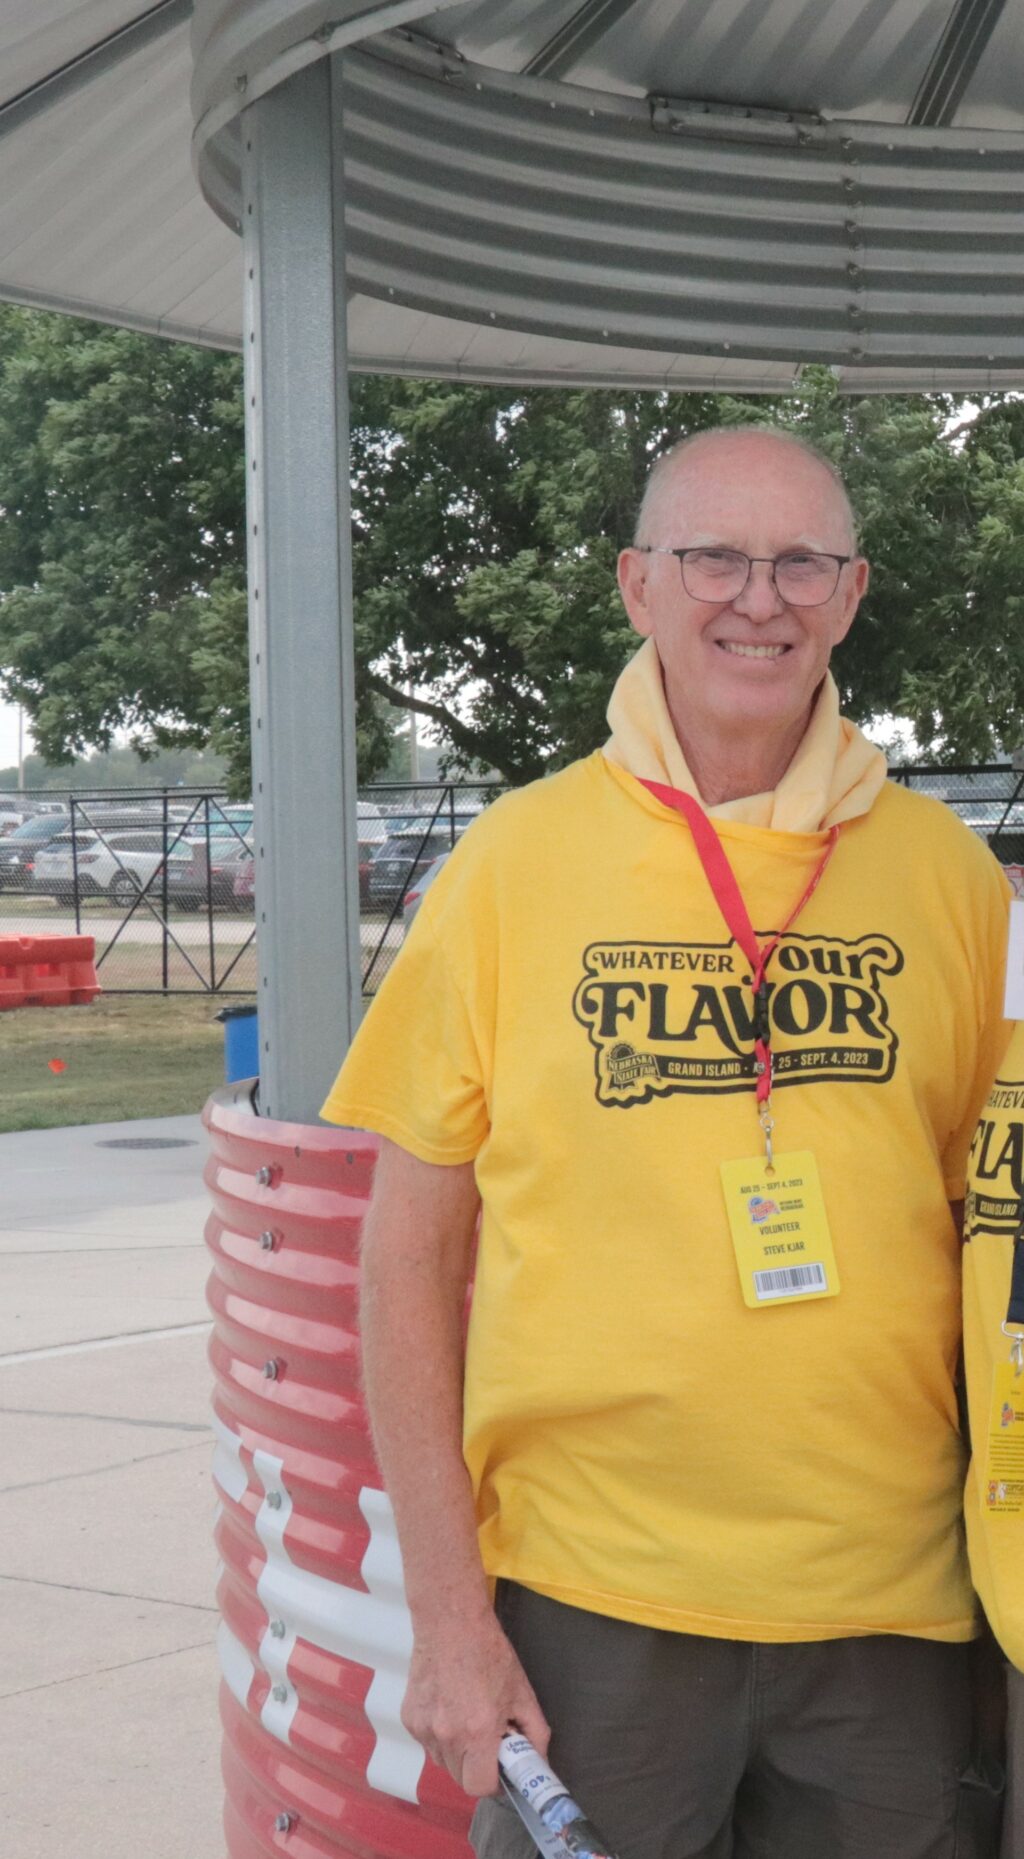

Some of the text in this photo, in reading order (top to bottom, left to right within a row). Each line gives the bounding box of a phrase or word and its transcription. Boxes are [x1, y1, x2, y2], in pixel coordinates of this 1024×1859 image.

[592, 951, 734, 973] WHATEVER
[581, 978, 886, 1057] FLAVOR
[668, 1062, 702, 1076] GRAND
[705, 1063, 741, 1077] ISLAND
[779, 1056, 792, 1069] 25
[801, 1053, 828, 1066] SEPT.
[843, 1052, 869, 1065] 2023
[759, 1221, 801, 1235] VOLUNTEER
[764, 1244, 786, 1255] STEVE
